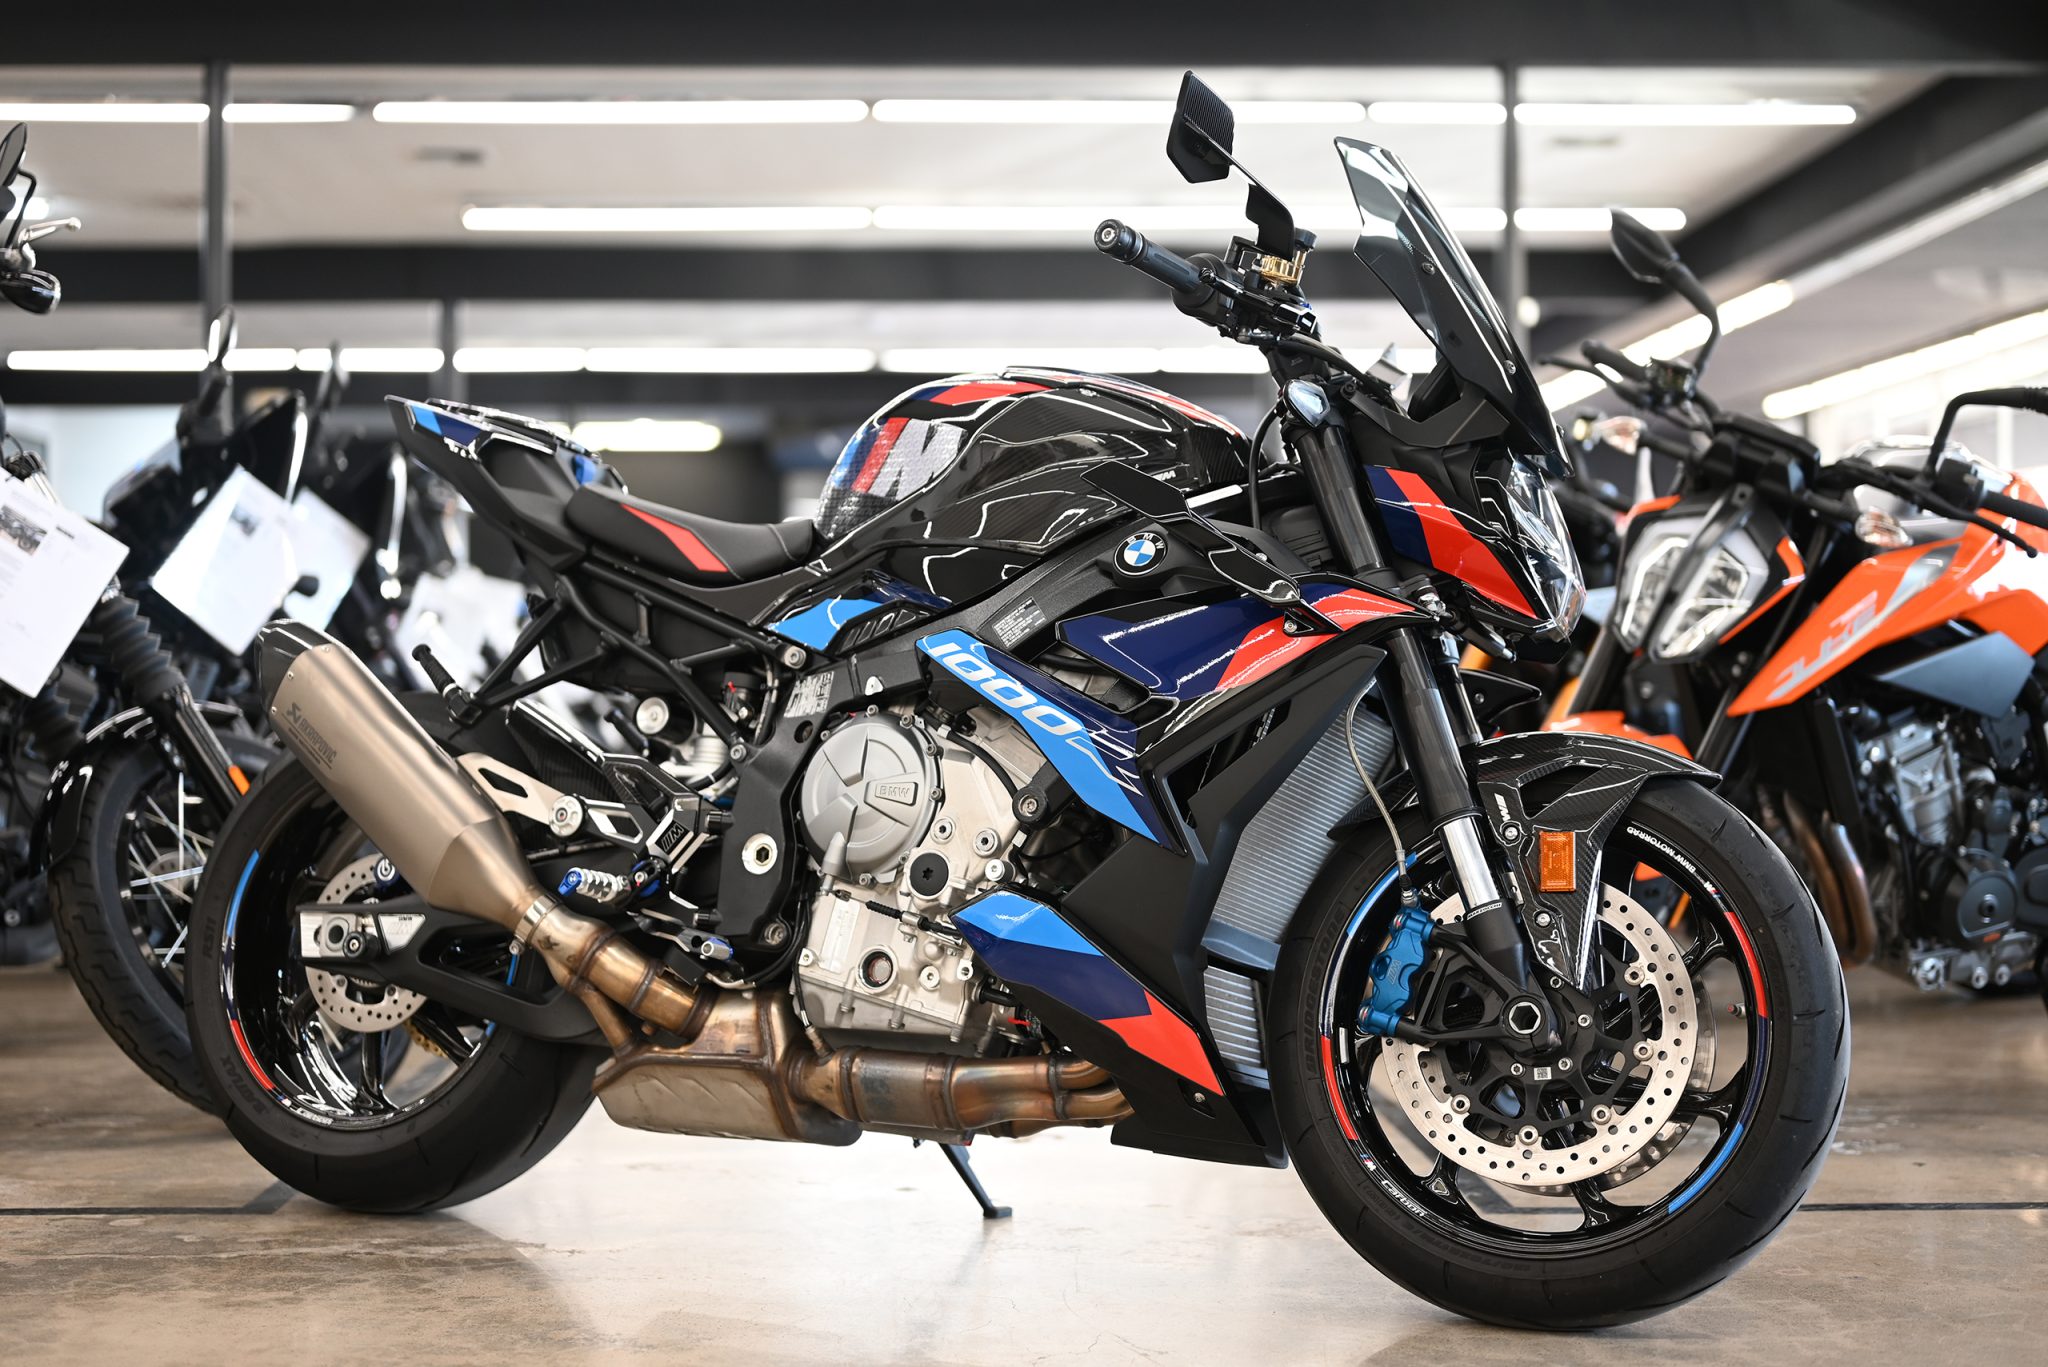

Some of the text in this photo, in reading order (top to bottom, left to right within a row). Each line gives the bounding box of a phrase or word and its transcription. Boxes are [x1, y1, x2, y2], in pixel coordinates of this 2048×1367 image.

[1126, 533, 1165, 549] BMW
[928, 642, 1084, 735] 1000
[879, 785, 911, 798] BMW
[1626, 826, 1697, 874] BMW MOTORRAD
[1304, 905, 1346, 1074] BRIDGESTONE
